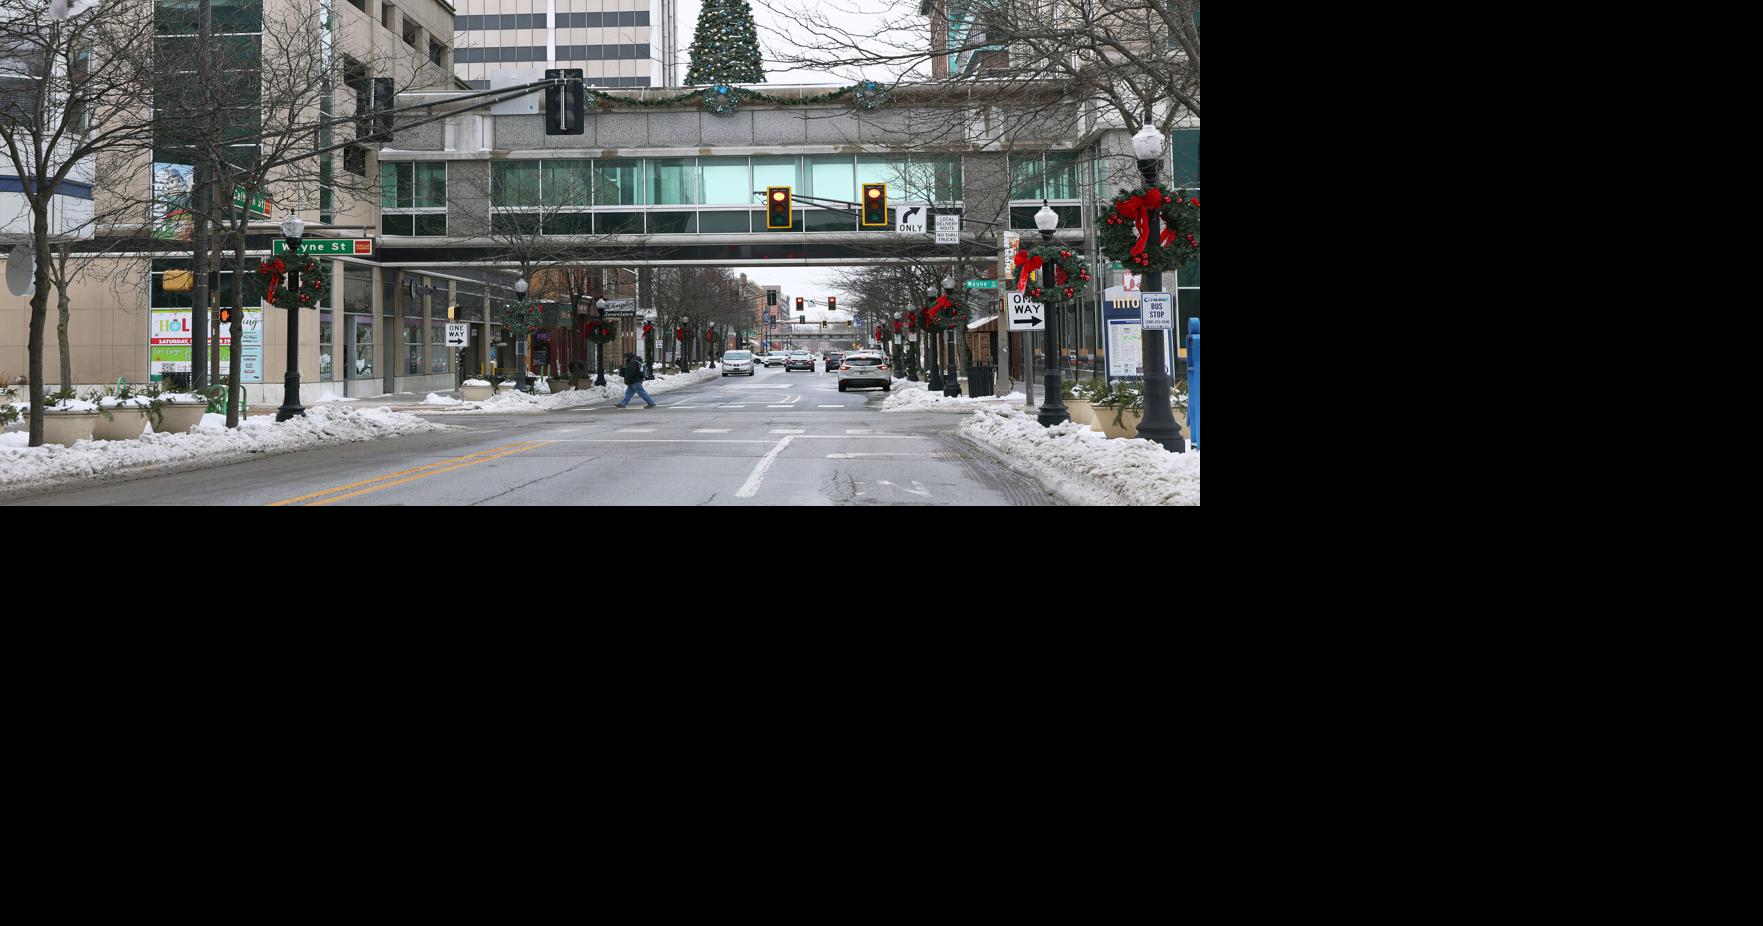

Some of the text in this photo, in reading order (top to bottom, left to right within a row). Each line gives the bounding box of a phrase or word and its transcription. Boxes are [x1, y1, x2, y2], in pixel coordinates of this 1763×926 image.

[900, 224, 922, 232] ONLY
[282, 242, 346, 253] Wyne St
[1013, 294, 1031, 304] ON
[1014, 304, 1041, 314] WAY
[1150, 302, 1163, 310] BUS
[1149, 310, 1165, 318] STOP
